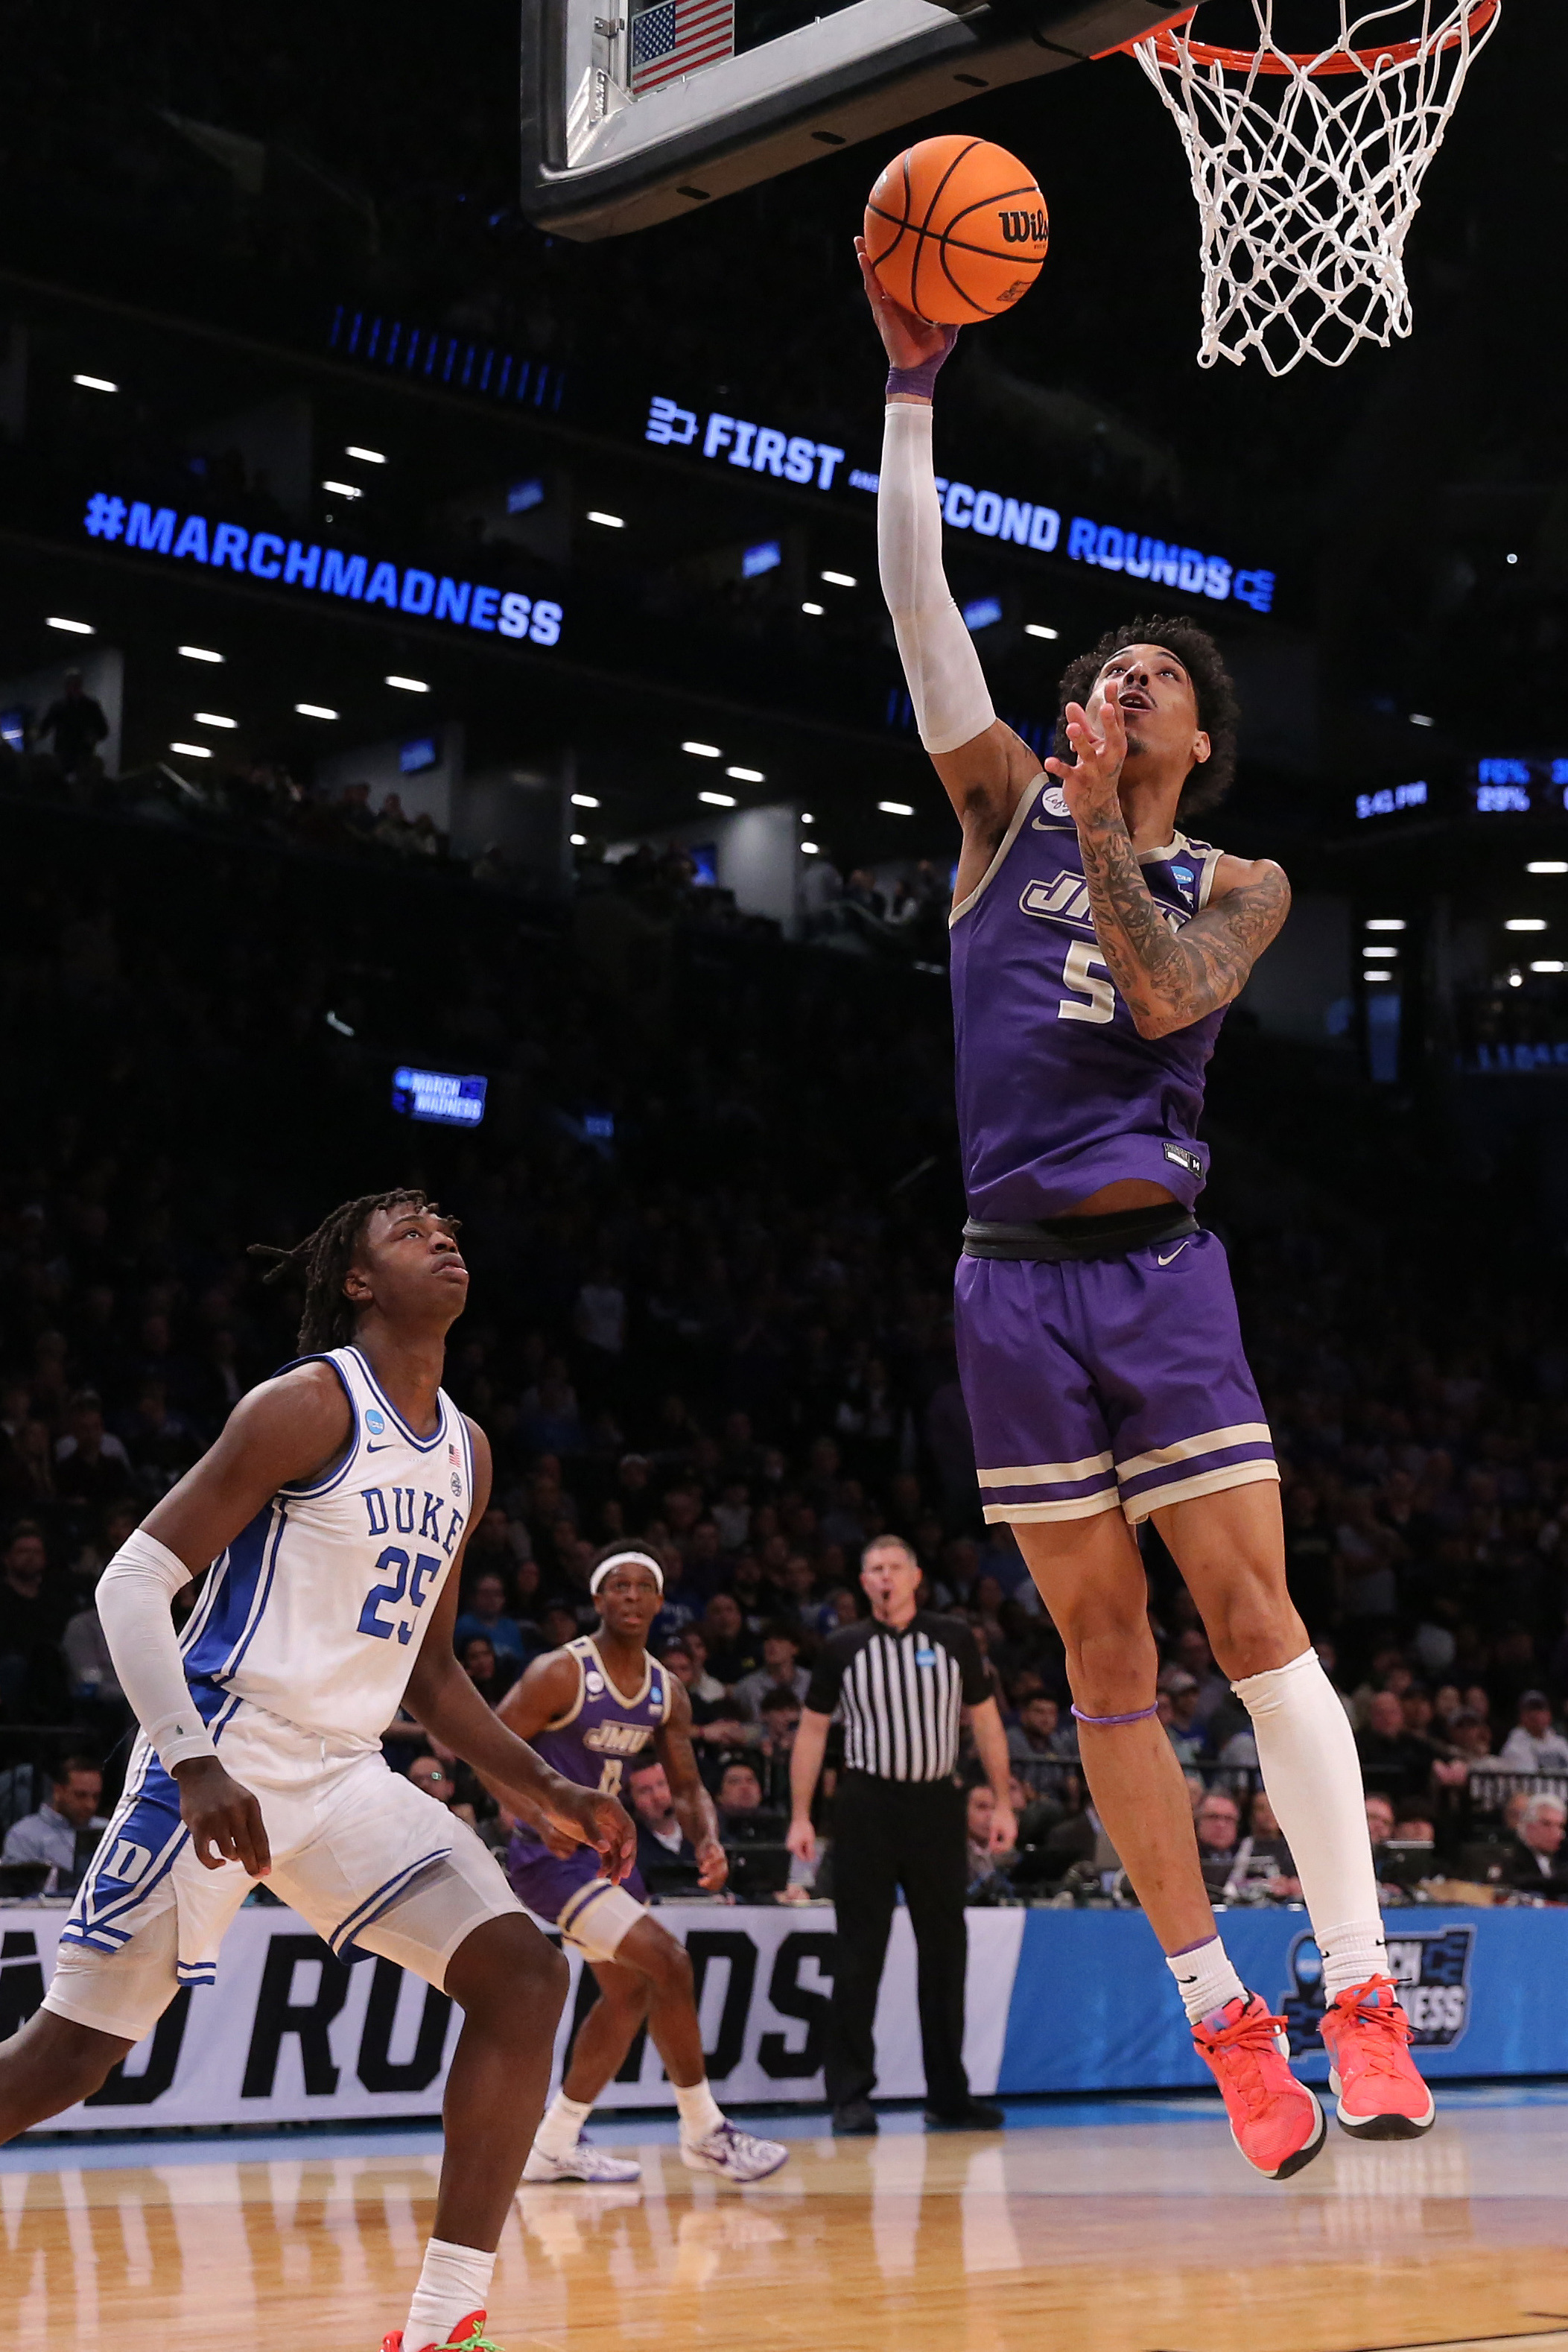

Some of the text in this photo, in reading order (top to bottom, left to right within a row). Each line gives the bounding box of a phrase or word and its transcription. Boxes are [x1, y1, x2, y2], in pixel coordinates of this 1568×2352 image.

[703, 413, 845, 490] FIRST
[934, 476, 1061, 553] COND
[1067, 516, 1234, 600] ROUNDS
[83, 492, 563, 646] #MARCHMADNESS
[1058, 940, 1115, 1024] 5
[361, 1488, 464, 1559] DUKE
[357, 1546, 442, 1645] 25
[585, 1719, 653, 1756] JMU
[101, 1838, 152, 1884] D
[241, 1931, 836, 2098] RODS
